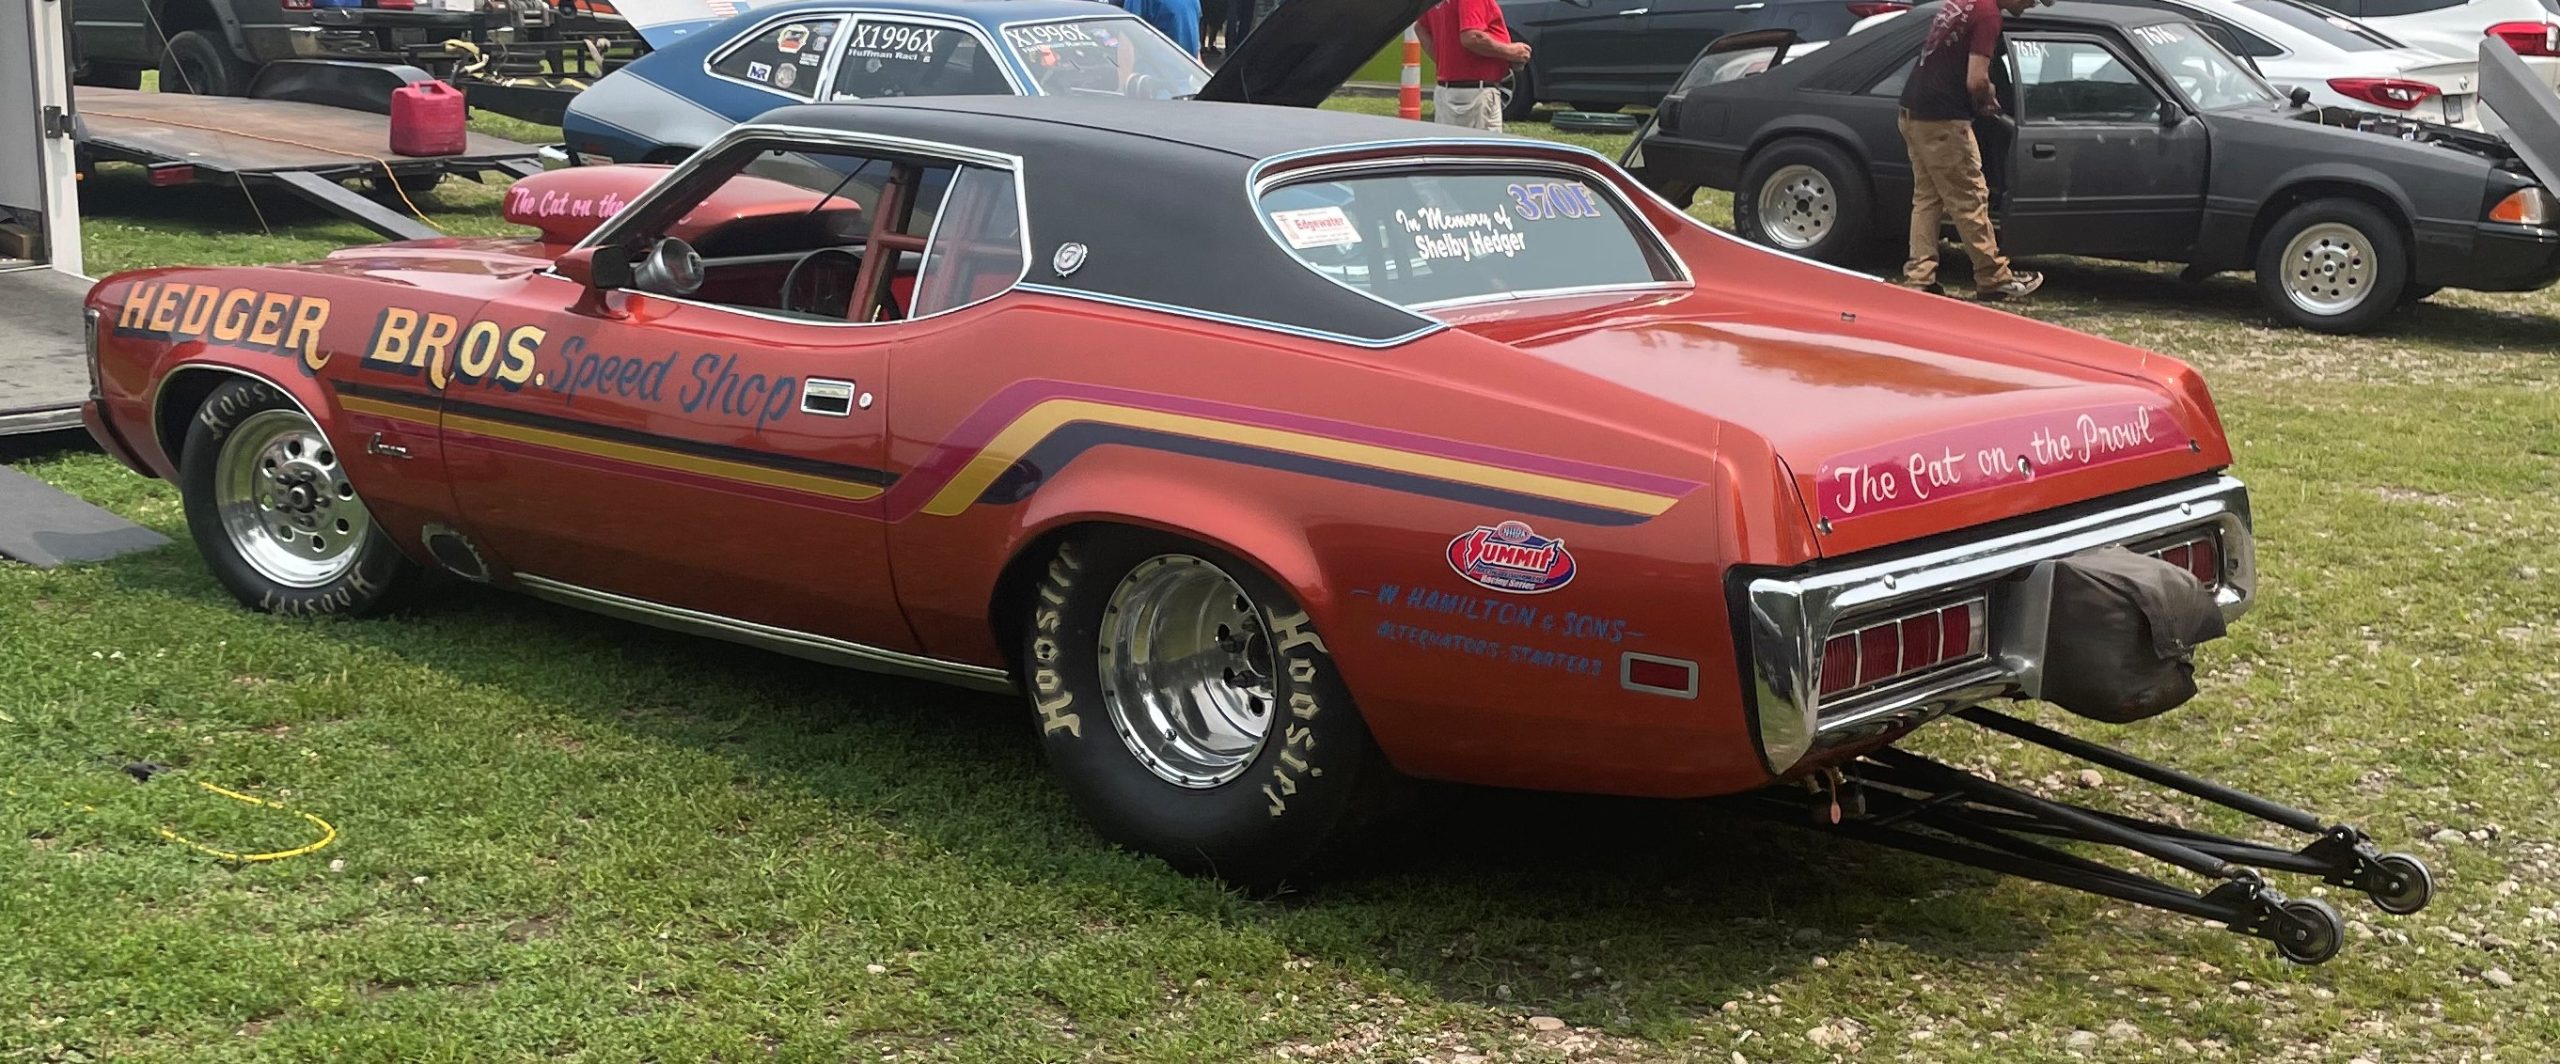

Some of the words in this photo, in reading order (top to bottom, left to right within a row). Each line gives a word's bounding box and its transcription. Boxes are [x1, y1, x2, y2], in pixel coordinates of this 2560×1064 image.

[850, 25, 940, 53] X1996X
[1005, 24, 1091, 48] X1996X
[539, 190, 571, 218] Cat
[571, 199, 593, 216] on
[1395, 208, 1421, 233] In
[1417, 206, 1491, 232] Memory
[1493, 203, 1514, 232] of
[1415, 233, 1473, 262] Shelby
[1469, 230, 1526, 258] Hedger
[115, 279, 333, 375] HEDGER
[363, 305, 546, 392] BROS.
[548, 335, 681, 407] Speed
[679, 351, 797, 437] Shop
[1904, 446, 1967, 500] Cat
[1978, 446, 2014, 477] on
[2030, 425, 2074, 466] the
[1465, 529, 1562, 573] SUMMIT
[1407, 586, 1538, 629] HAMILTON
[1264, 604, 1329, 818] Hoosier
